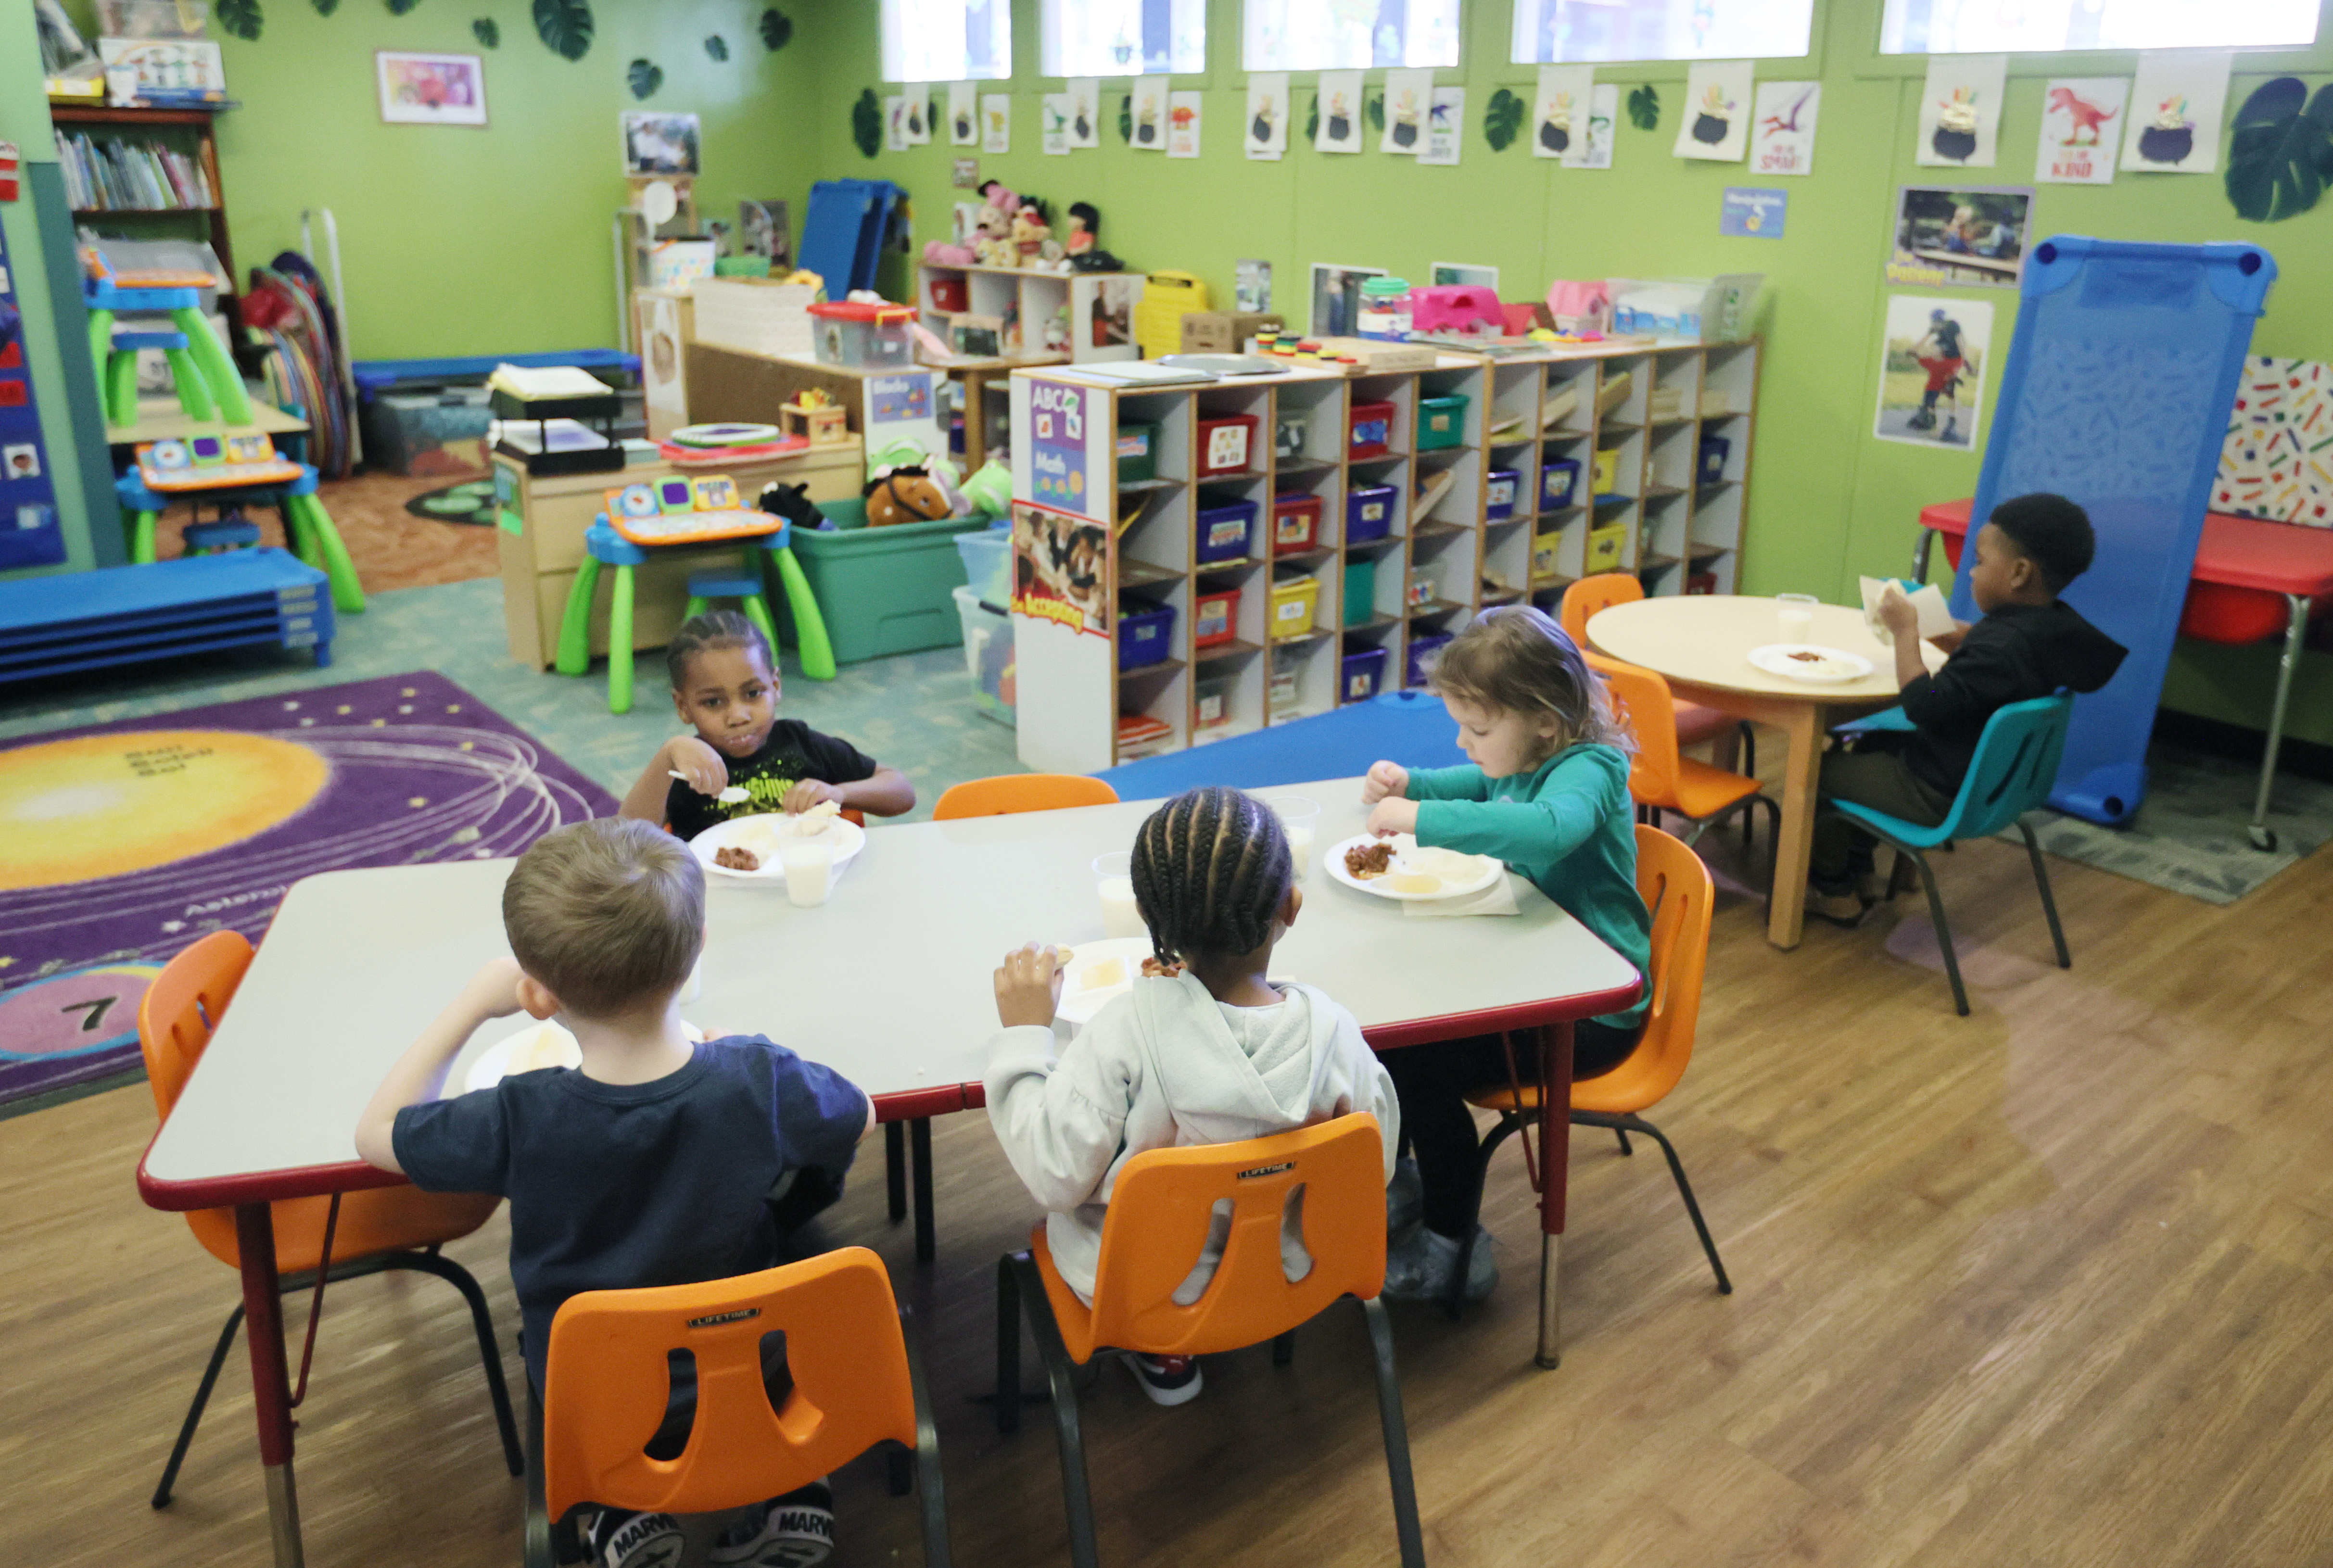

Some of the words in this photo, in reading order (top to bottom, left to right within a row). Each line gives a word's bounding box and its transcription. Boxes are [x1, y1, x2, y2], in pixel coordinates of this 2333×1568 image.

[2052, 163, 2092, 178] KIND
[874, 377, 909, 393] Blocks
[1036, 451, 1066, 475] Math
[61, 995, 118, 1031] 7
[1245, 1163, 1288, 1176] LIFETIME
[697, 1309, 749, 1324] LIFETIME
[778, 1512, 834, 1538] MARV
